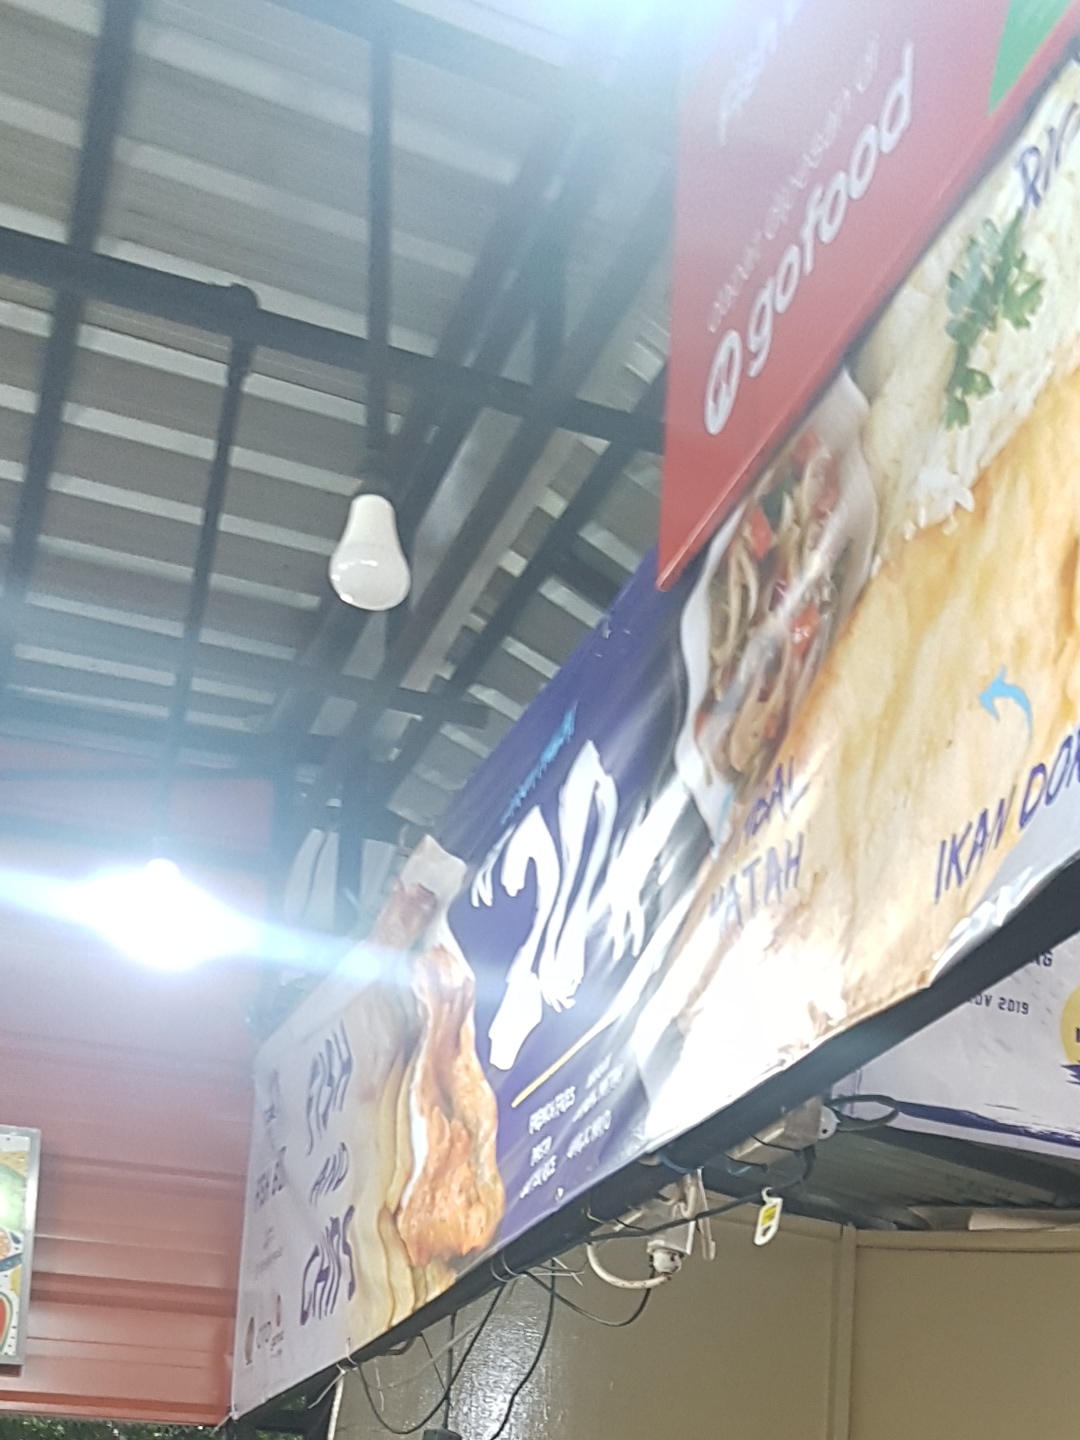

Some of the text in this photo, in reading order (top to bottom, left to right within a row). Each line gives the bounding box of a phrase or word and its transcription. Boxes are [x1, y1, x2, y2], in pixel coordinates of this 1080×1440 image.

[746, 42, 914, 378] gofood
[934, 783, 1017, 905] IKAN
[998, 997, 1029, 1015] 2019
